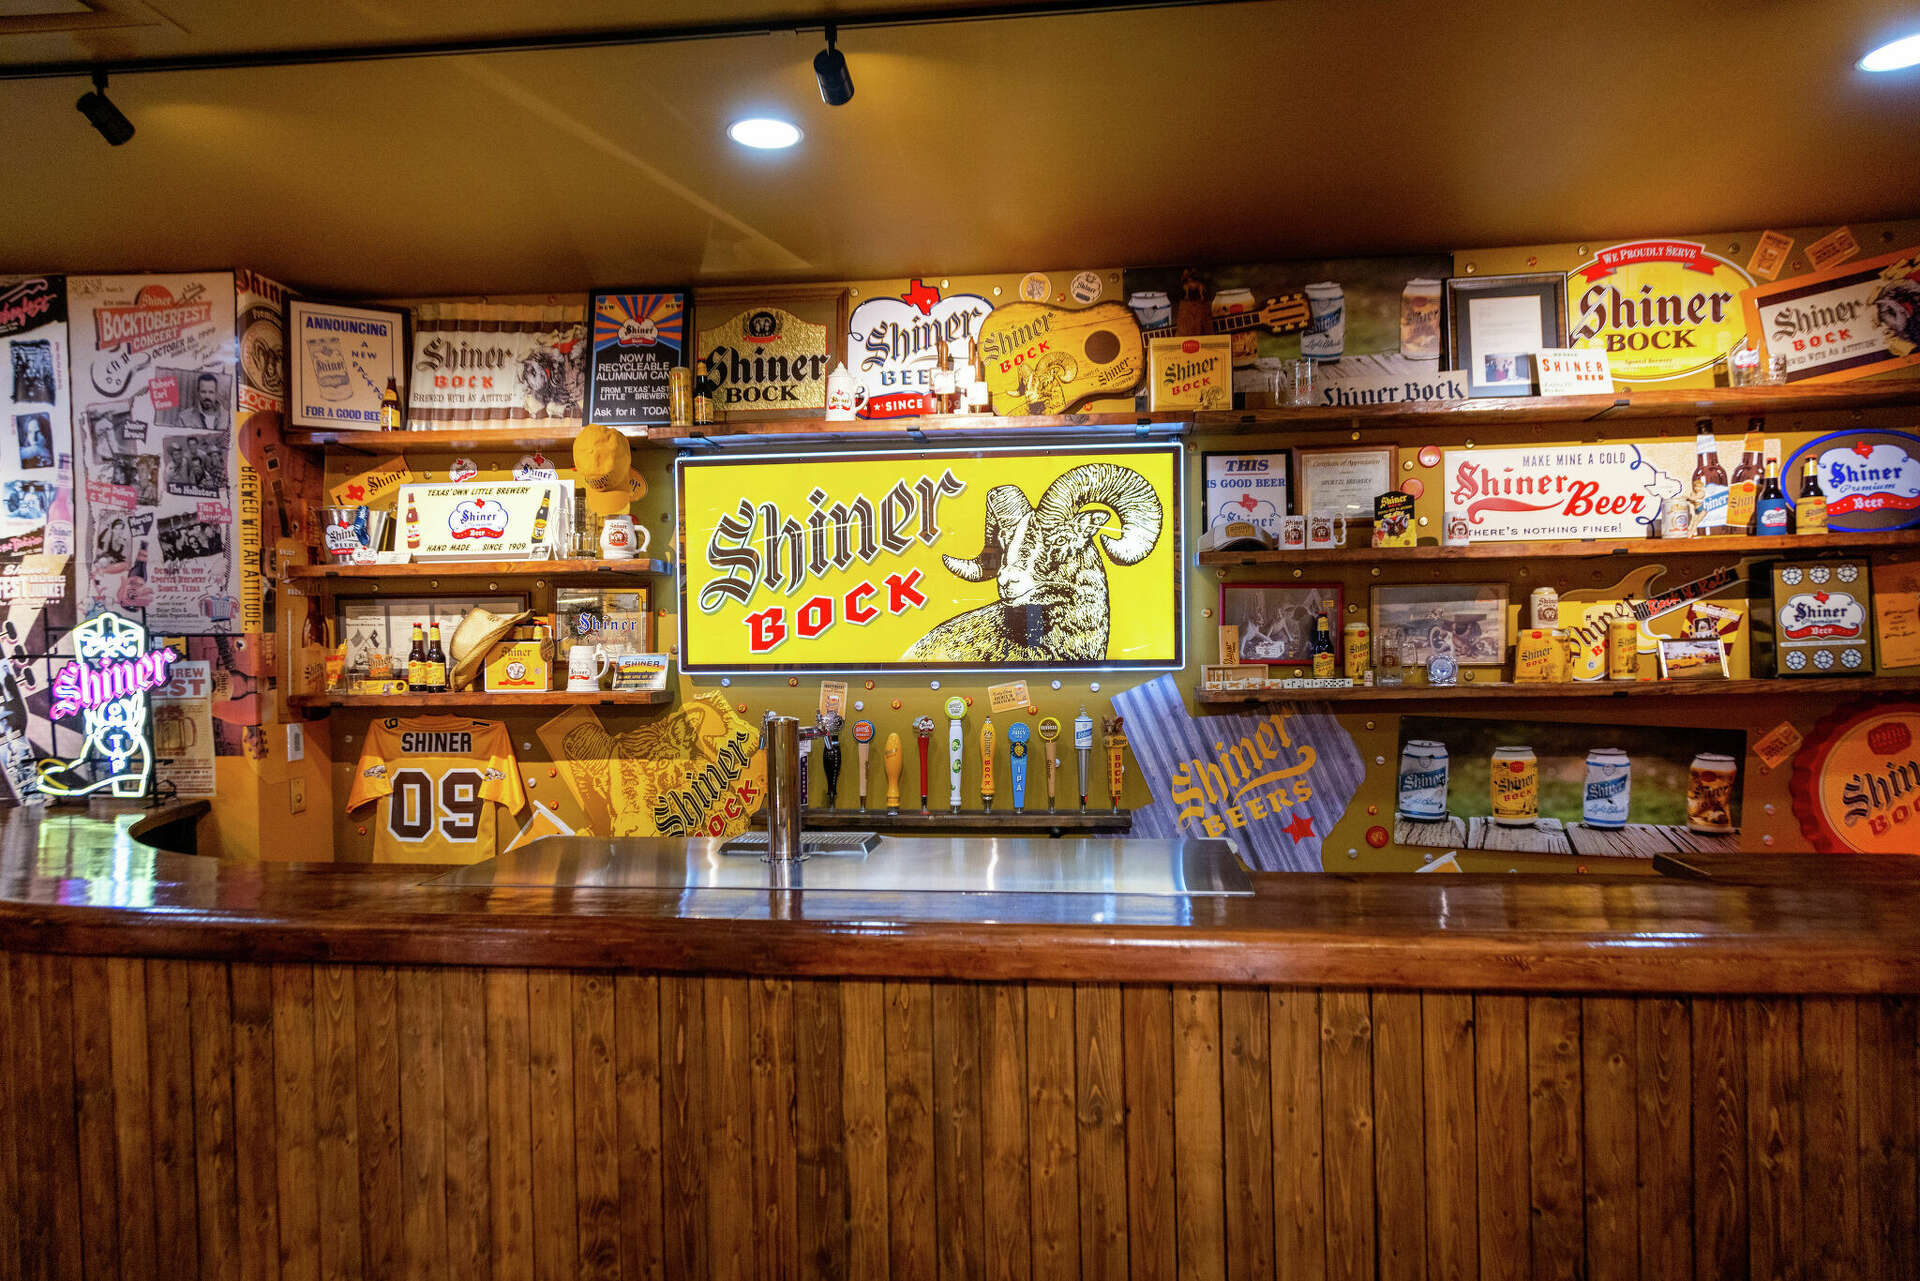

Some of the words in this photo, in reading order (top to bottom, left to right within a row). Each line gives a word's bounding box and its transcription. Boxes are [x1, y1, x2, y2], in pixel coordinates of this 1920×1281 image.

[1620, 247, 1665, 260] PROUDLY
[1665, 245, 1697, 258] SERVE
[102, 305, 209, 341] BOCKTOBERFEST
[306, 316, 387, 336] ANNOUNCING
[1568, 284, 1735, 349] Shiner
[1771, 299, 1865, 343] Shiner
[133, 328, 179, 348] CONCERT
[624, 323, 654, 336] Shiner
[983, 311, 1057, 368] Shiner
[1792, 328, 1853, 351] BOCK
[361, 340, 368, 348] A
[861, 307, 983, 373] Shiner
[1605, 328, 1697, 353] BOCK
[351, 350, 377, 360] NEW
[416, 336, 513, 372] Shiner
[620, 354, 644, 363] NOW
[646, 353, 656, 362] IN
[1000, 339, 1051, 374] BOCK
[599, 362, 670, 372] RECYCLEABLE
[704, 345, 831, 393] Shiner
[1097, 356, 1131, 386] Shiner
[1164, 356, 1219, 384] Shiner
[1542, 358, 1604, 372] SHINER
[352, 361, 384, 401] PACKAG
[434, 375, 494, 389] BOCK
[596, 371, 647, 381] ALUMINUM
[879, 369, 930, 386] BEE
[1171, 376, 1212, 396] BOCK
[600, 386, 621, 394] FROM
[600, 393, 625, 401] LITTLE
[726, 384, 800, 403] BOCK
[1320, 382, 1400, 407] Shiner
[1401, 379, 1464, 403] Bock
[305, 405, 324, 417] FOR
[327, 407, 333, 417] A
[336, 409, 361, 420] GOOD
[364, 411, 381, 421] BEE
[594, 408, 611, 417] Ask
[616, 408, 628, 416] for
[885, 398, 923, 411] SINCE
[1225, 459, 1269, 472] THIS
[1522, 454, 1551, 467] MAKE
[1556, 453, 1582, 466] MINE
[1588, 453, 1594, 464] A
[1599, 451, 1626, 464] COLD
[366, 467, 408, 496] Shiner
[1206, 478, 1216, 488] IS
[1221, 478, 1252, 488] GOOD
[1255, 478, 1286, 488] BEER
[1828, 462, 1904, 489] Shiner
[169, 484, 181, 493] The
[183, 484, 218, 498] Hollisters
[241, 466, 258, 514] BREWED
[471, 487, 492, 496] LITTLE
[496, 486, 531, 495] BREWERY
[1451, 460, 1568, 505] Shiner
[1562, 480, 1646, 517] Beer
[1852, 498, 1885, 509] Beer
[460, 509, 496, 525] Shiner
[242, 519, 259, 546] WITH
[329, 529, 357, 543] Shine
[700, 467, 968, 613] Shiner
[1468, 526, 1518, 537] THERE'S
[1523, 525, 1578, 535] NOTHING
[1583, 523, 1622, 533] FINER!
[426, 543, 448, 552] HAND
[482, 543, 504, 551] SINCE
[508, 542, 527, 551] 1909
[243, 551, 260, 565] AN
[243, 570, 261, 631] ATTITUDE.
[744, 567, 928, 653] BOCK
[1793, 601, 1848, 622] Shiner
[577, 612, 637, 635] Shiner
[1810, 626, 1833, 635] Beer
[1521, 646, 1553, 661] Shiner
[625, 660, 660, 668] SHINER
[51, 648, 177, 720] Shiner
[401, 731, 472, 753] SHINER
[1015, 766, 1023, 792] IPA
[1172, 707, 1294, 831] Shiner
[653, 731, 750, 837] Shiner
[1403, 771, 1446, 790] Shiner
[1495, 773, 1535, 793] Shiner
[1588, 780, 1626, 800] Shiner
[1503, 789, 1532, 802] BOCK
[1842, 760, 1920, 828] Shin
[388, 768, 485, 842] 09
[694, 780, 757, 837] OCK
[1202, 779, 1313, 838] BEERS
